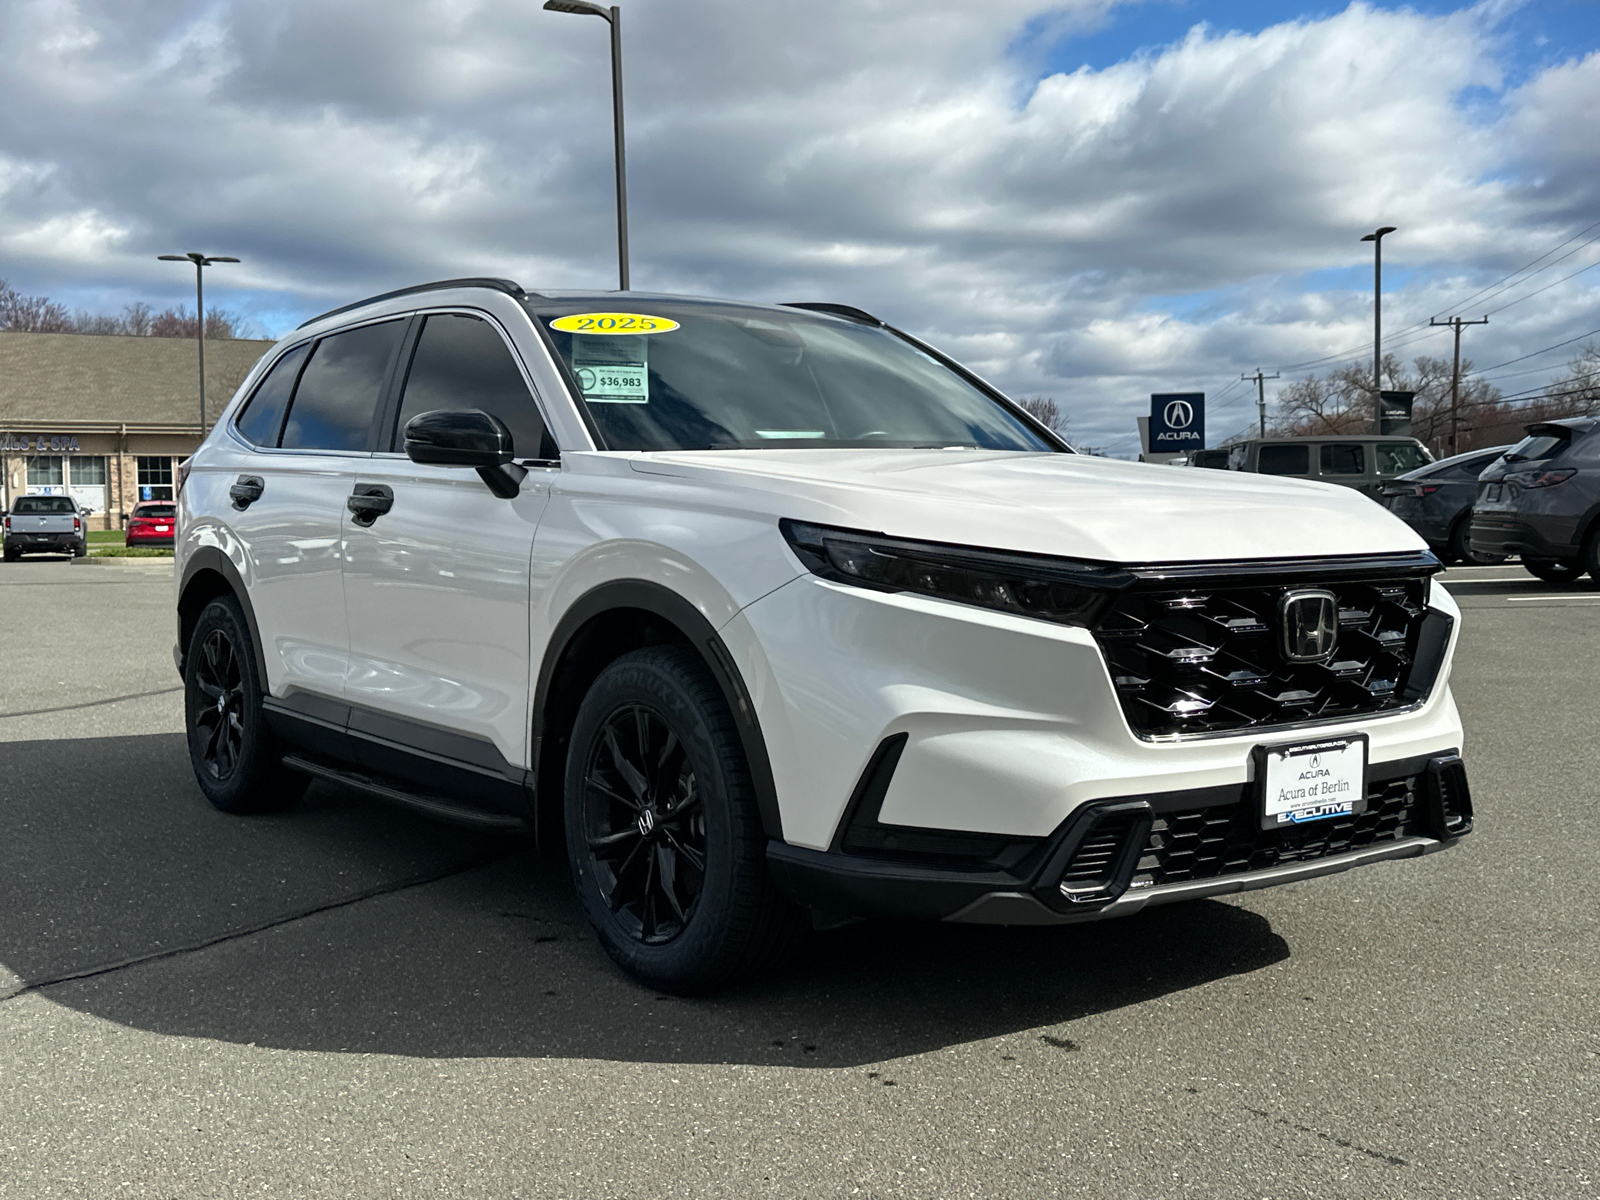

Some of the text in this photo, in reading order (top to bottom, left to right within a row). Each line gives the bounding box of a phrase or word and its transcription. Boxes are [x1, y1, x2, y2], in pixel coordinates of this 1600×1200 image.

[577, 317, 657, 331] 2025
[600, 376, 642, 388] $36,983
[1156, 431, 1201, 441] ACURA
[36, 436, 47, 451] &
[50, 436, 80, 451] SPA
[1298, 769, 1331, 780] ACURA
[1278, 779, 1350, 801] Acura of Berlin
[1277, 802, 1353, 823] EXECUTIVE
